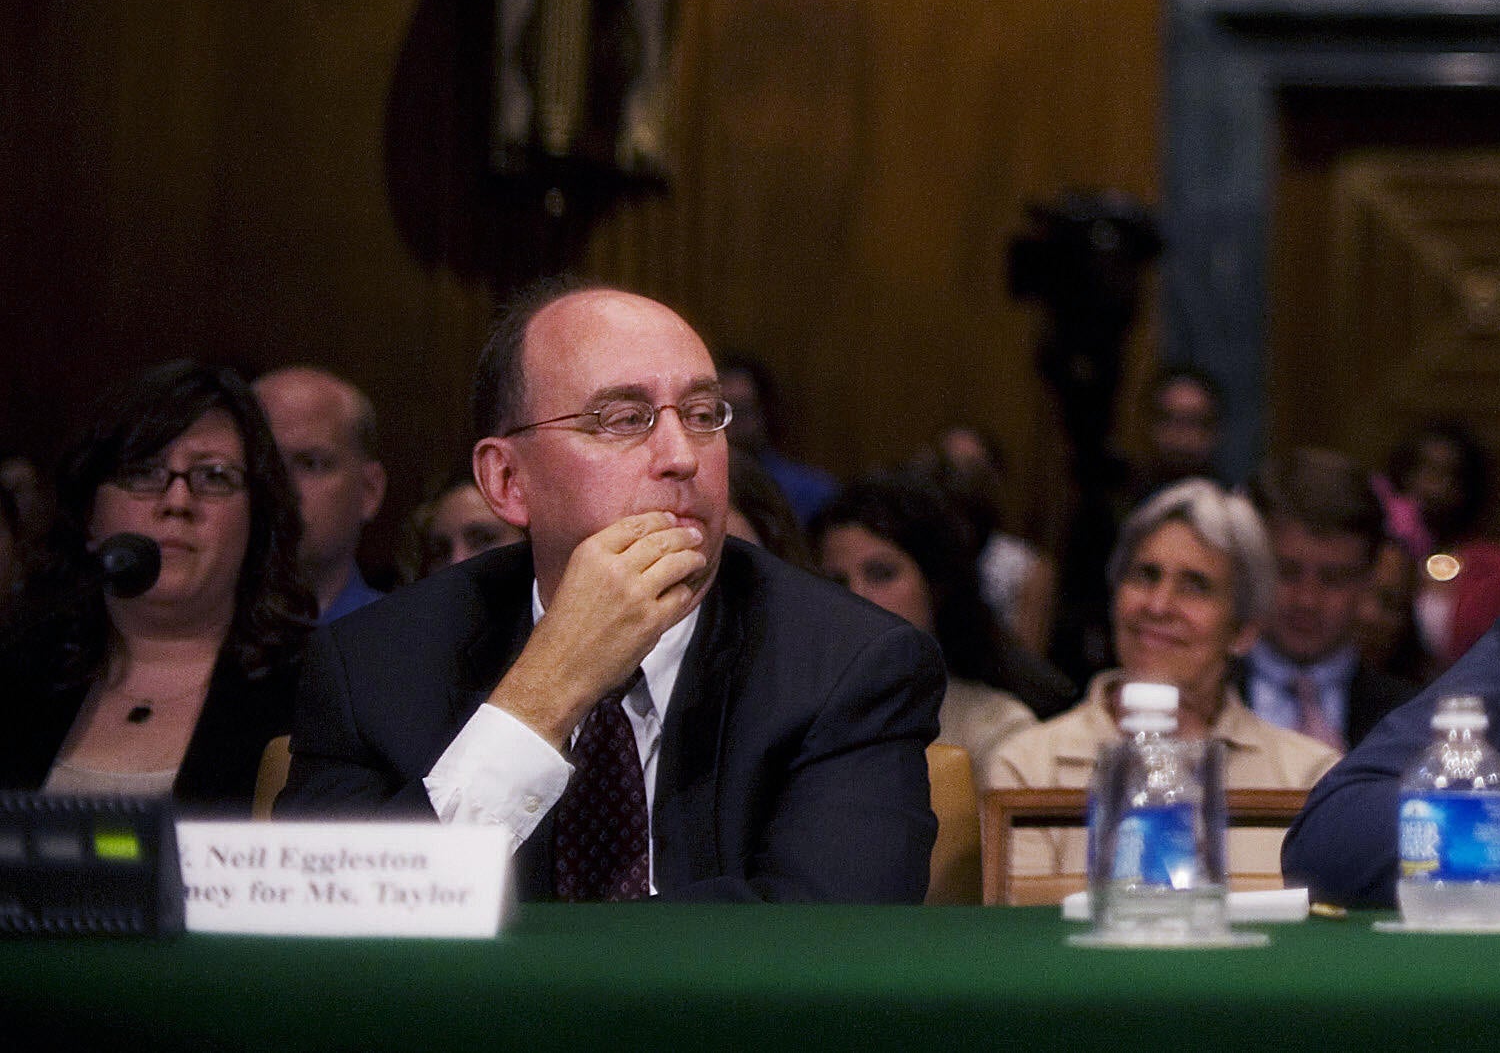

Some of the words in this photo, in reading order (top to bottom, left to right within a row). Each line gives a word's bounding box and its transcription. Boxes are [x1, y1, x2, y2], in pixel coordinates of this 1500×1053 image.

[207, 845, 268, 868] Neil
[278, 845, 429, 875] Eggleston
[249, 880, 294, 903] for
[305, 881, 360, 904] Ms.
[376, 881, 471, 913] Taylor
